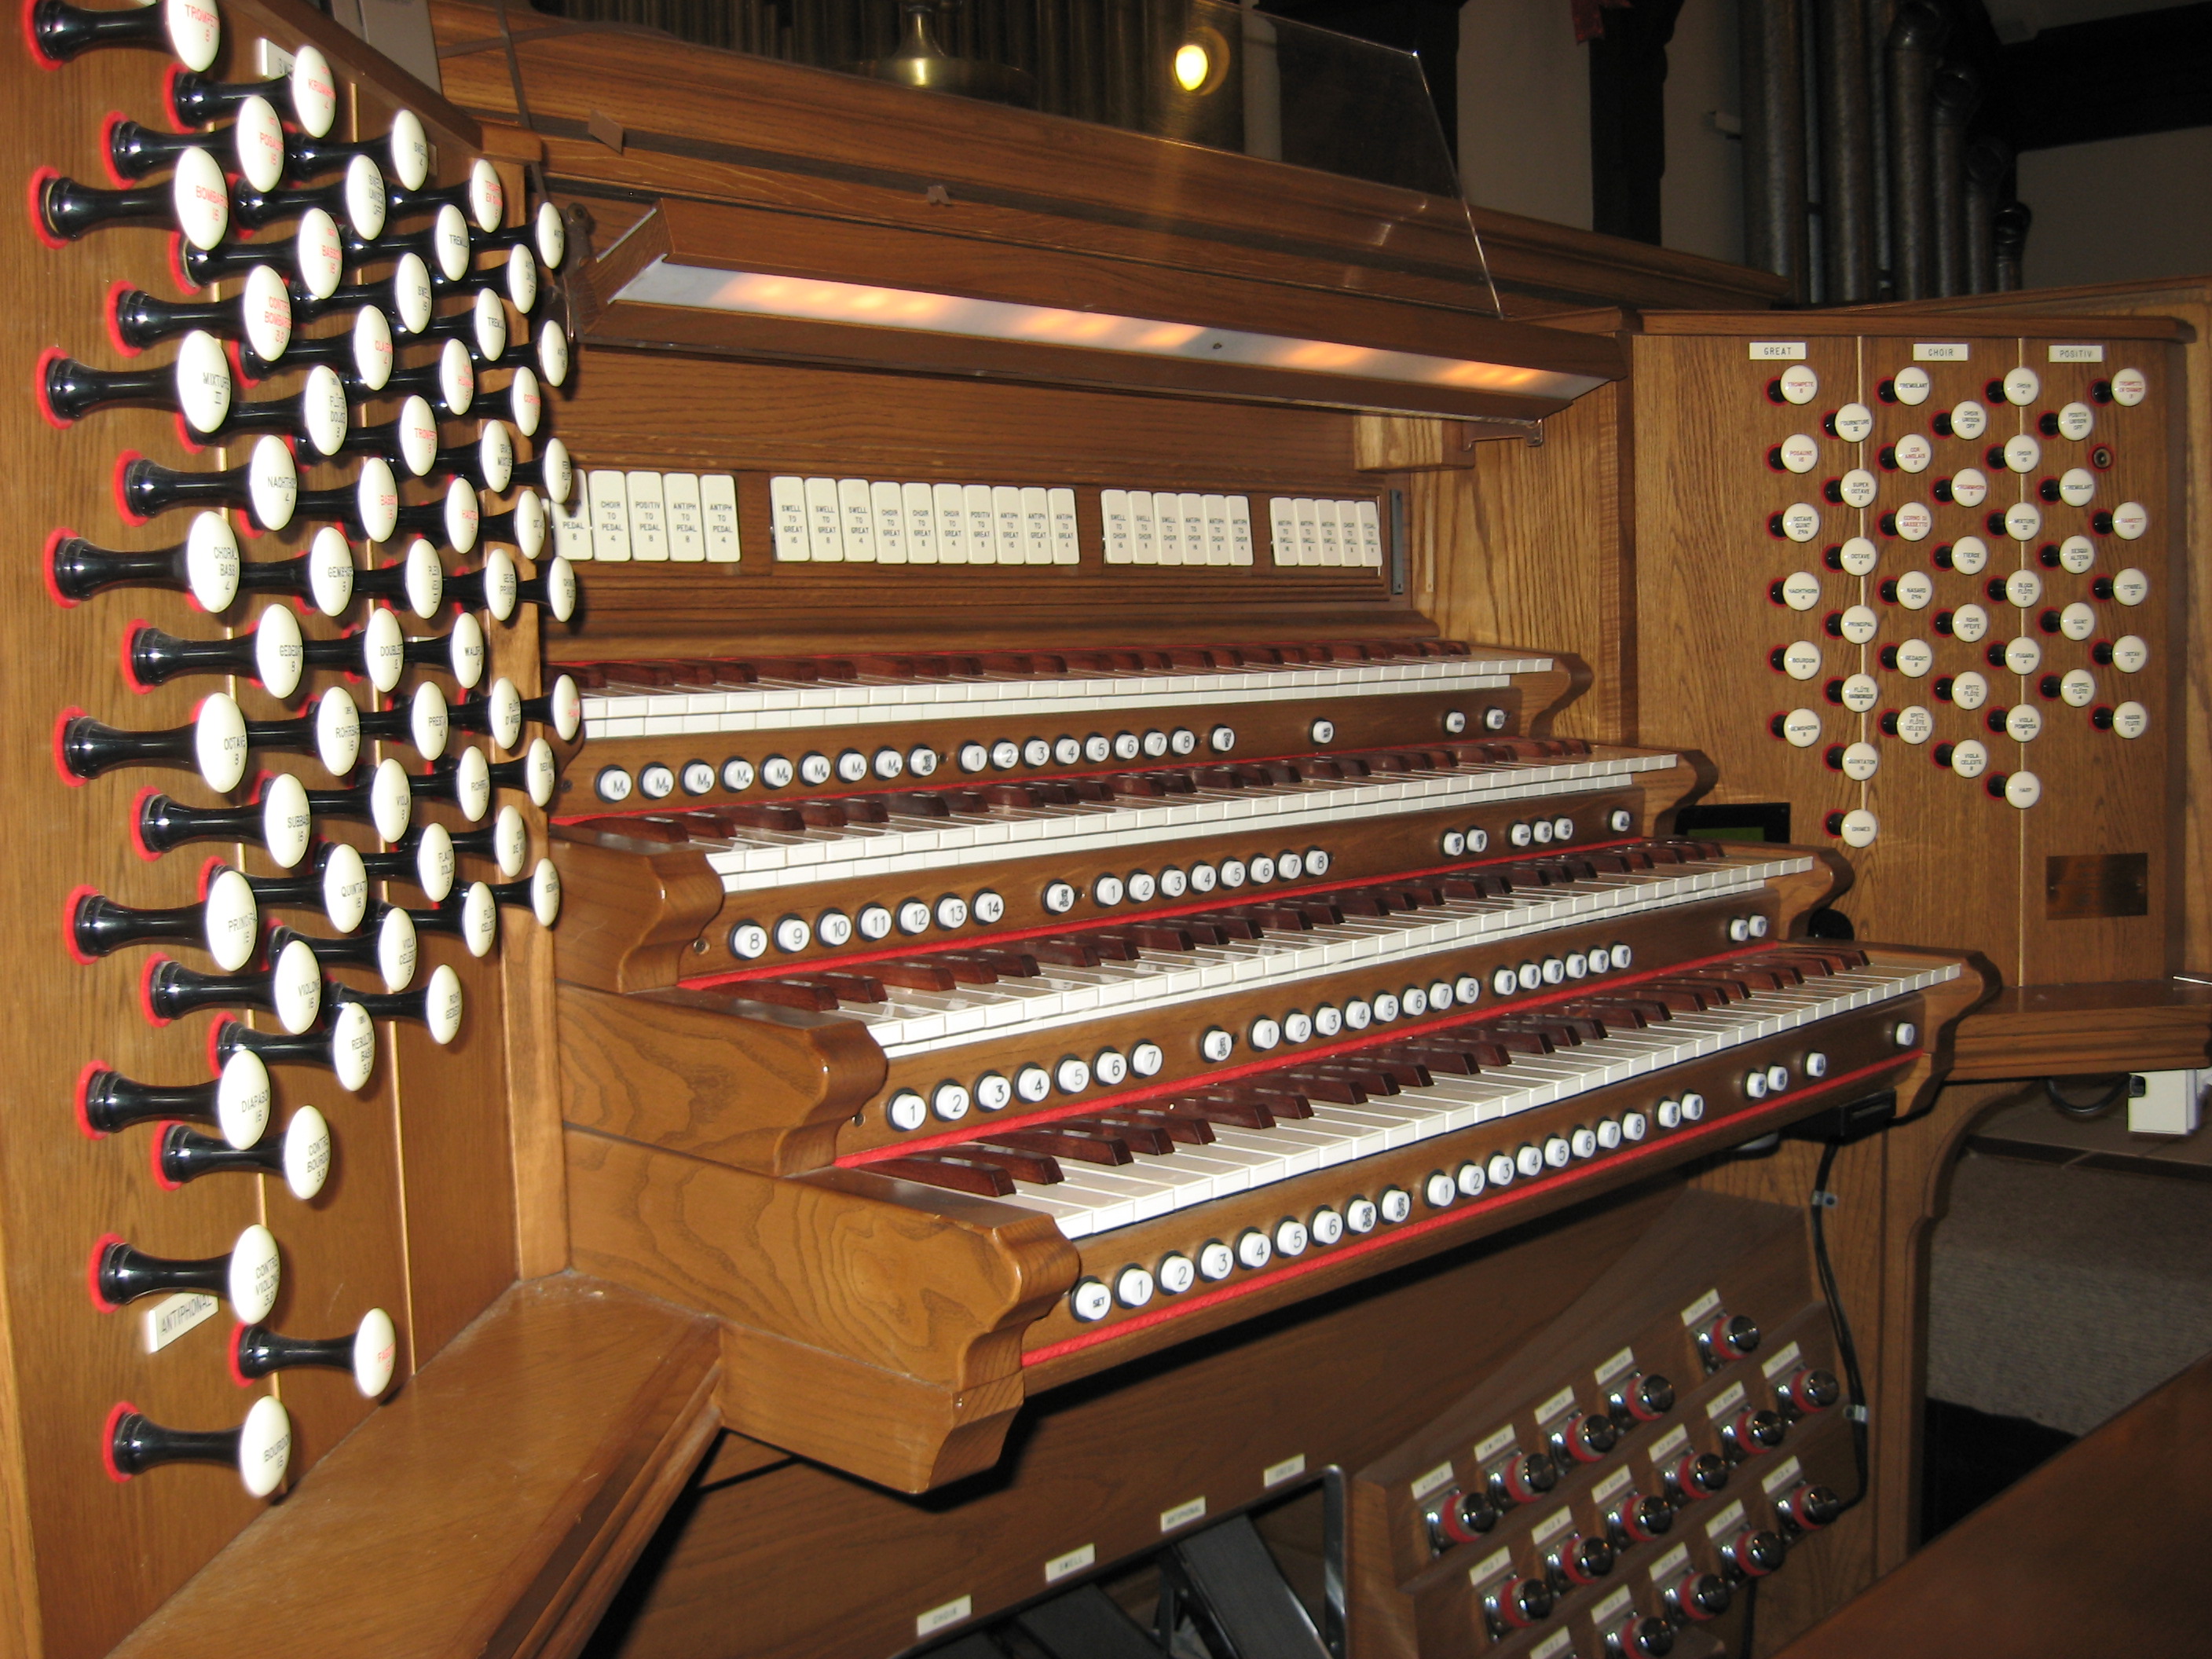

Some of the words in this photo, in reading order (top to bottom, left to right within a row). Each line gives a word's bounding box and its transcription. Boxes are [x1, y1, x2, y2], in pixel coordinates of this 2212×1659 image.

[602, 523, 623, 532] PEDAL
[639, 523, 661, 532] PEDAL
[1127, 740, 1134, 753] 6
[1157, 738, 1163, 750] 7
[1184, 736, 1190, 748] 8
[1006, 749, 1013, 763] 2
[1037, 748, 1046, 760] 3
[1068, 746, 1075, 759] 4
[1098, 744, 1105, 757] 5
[975, 753, 980, 765] 1
[737, 769, 749, 783] M4
[776, 767, 789, 781] M5
[852, 762, 864, 776] M7
[613, 780, 626, 794] M1
[656, 778, 669, 792] M2
[698, 774, 710, 789] M3
[1291, 859, 1298, 872] 7
[1318, 856, 1324, 869] 8
[1234, 868, 1241, 881] 5
[1263, 864, 1270, 877] 6
[1174, 877, 1182, 891] 3
[1204, 873, 1211, 885] 4
[1111, 885, 1116, 898] 1
[1142, 881, 1149, 895] 2
[950, 906, 964, 921] 13
[988, 901, 1001, 917] 14
[873, 915, 886, 932] 11
[914, 909, 927, 926] 12
[793, 928, 803, 944] 9
[833, 921, 848, 937] 10
[749, 932, 760, 950] 8
[1443, 988, 1449, 1002] 7
[1469, 983, 1475, 997] 8
[1387, 1002, 1394, 1016] 5
[1416, 995, 1423, 1009] 6
[1330, 1015, 1337, 1030] 3
[1359, 1009, 1366, 1023] 4
[1268, 1027, 1272, 1042] 1
[1299, 1022, 1306, 1037] 2
[1148, 1051, 1157, 1068] 7
[1112, 1060, 1120, 1076] 6
[1075, 1068, 1084, 1086] 5
[1035, 1078, 1043, 1094] 4
[995, 1085, 1004, 1103] 3
[953, 1094, 962, 1112] 2
[910, 1104, 916, 1121] 1
[1635, 1120, 1642, 1133] 8
[1611, 1127, 1617, 1141] 7
[1586, 1137, 1592, 1150] 6
[1559, 1147, 1566, 1161] 5
[1532, 1155, 1538, 1169] 4
[1503, 1163, 1510, 1178] 3
[1473, 1174, 1480, 1189] 2
[1445, 1185, 1448, 1199] 1
[1329, 1219, 1337, 1235] 6
[1294, 1231, 1302, 1248] 5
[1256, 1243, 1265, 1259] 4
[1219, 1254, 1227, 1272] 3
[1178, 1267, 1187, 1285] 2
[1138, 1280, 1144, 1297] 1
[1093, 1298, 1105, 1308] SET
[162, 1295, 212, 1335] ANTIPHONAL
